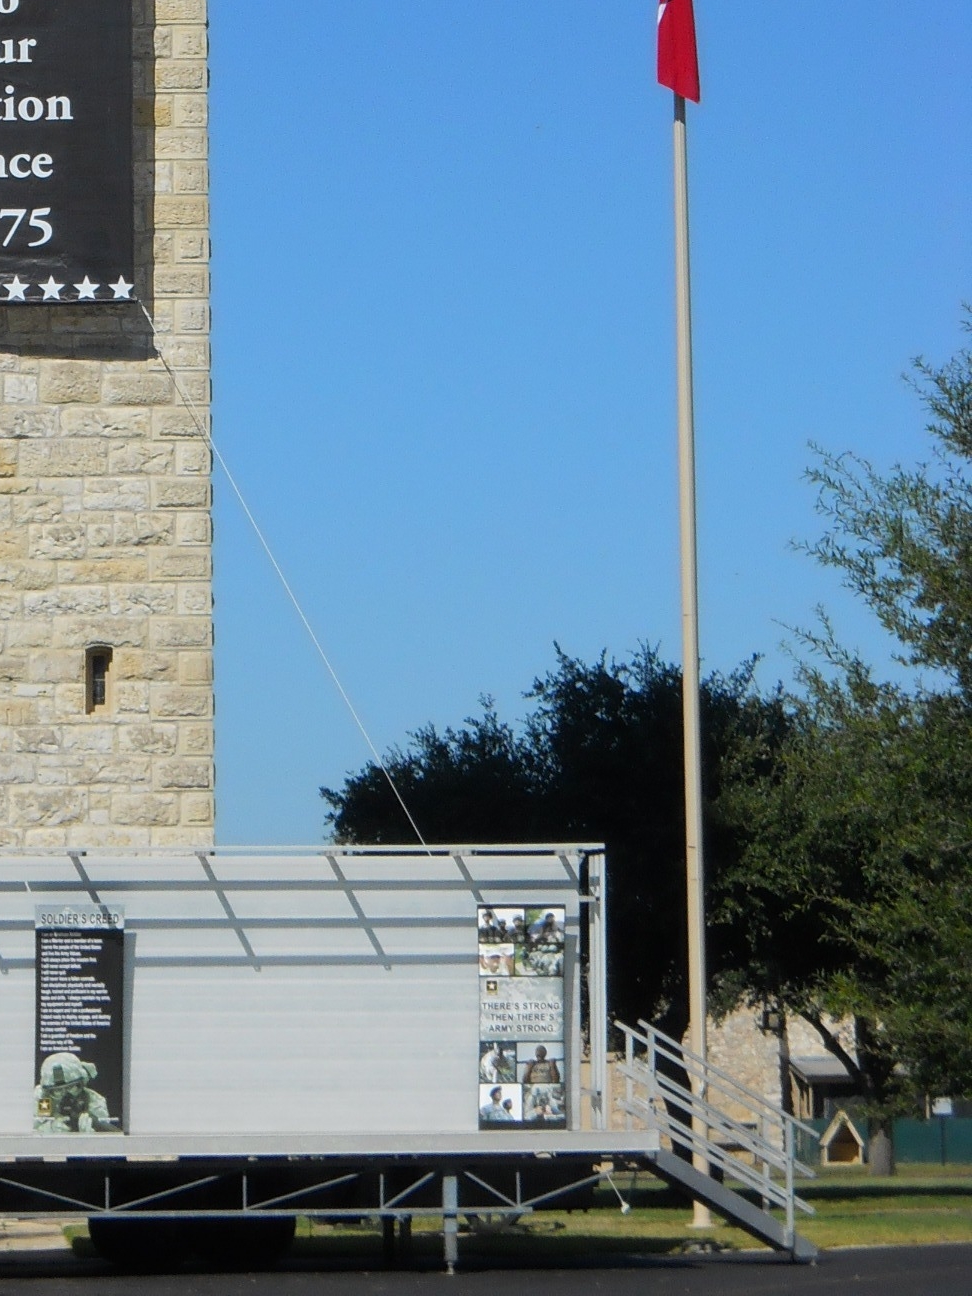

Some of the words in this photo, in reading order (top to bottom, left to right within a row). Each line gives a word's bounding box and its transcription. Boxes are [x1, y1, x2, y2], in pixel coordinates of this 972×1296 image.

[89, 913, 119, 924] CREED
[482, 1002, 520, 1010] THERE'S
[490, 1013, 514, 1021] THEN
[517, 1013, 555, 1021] THERE'S
[488, 1024, 513, 1032] ARMY
